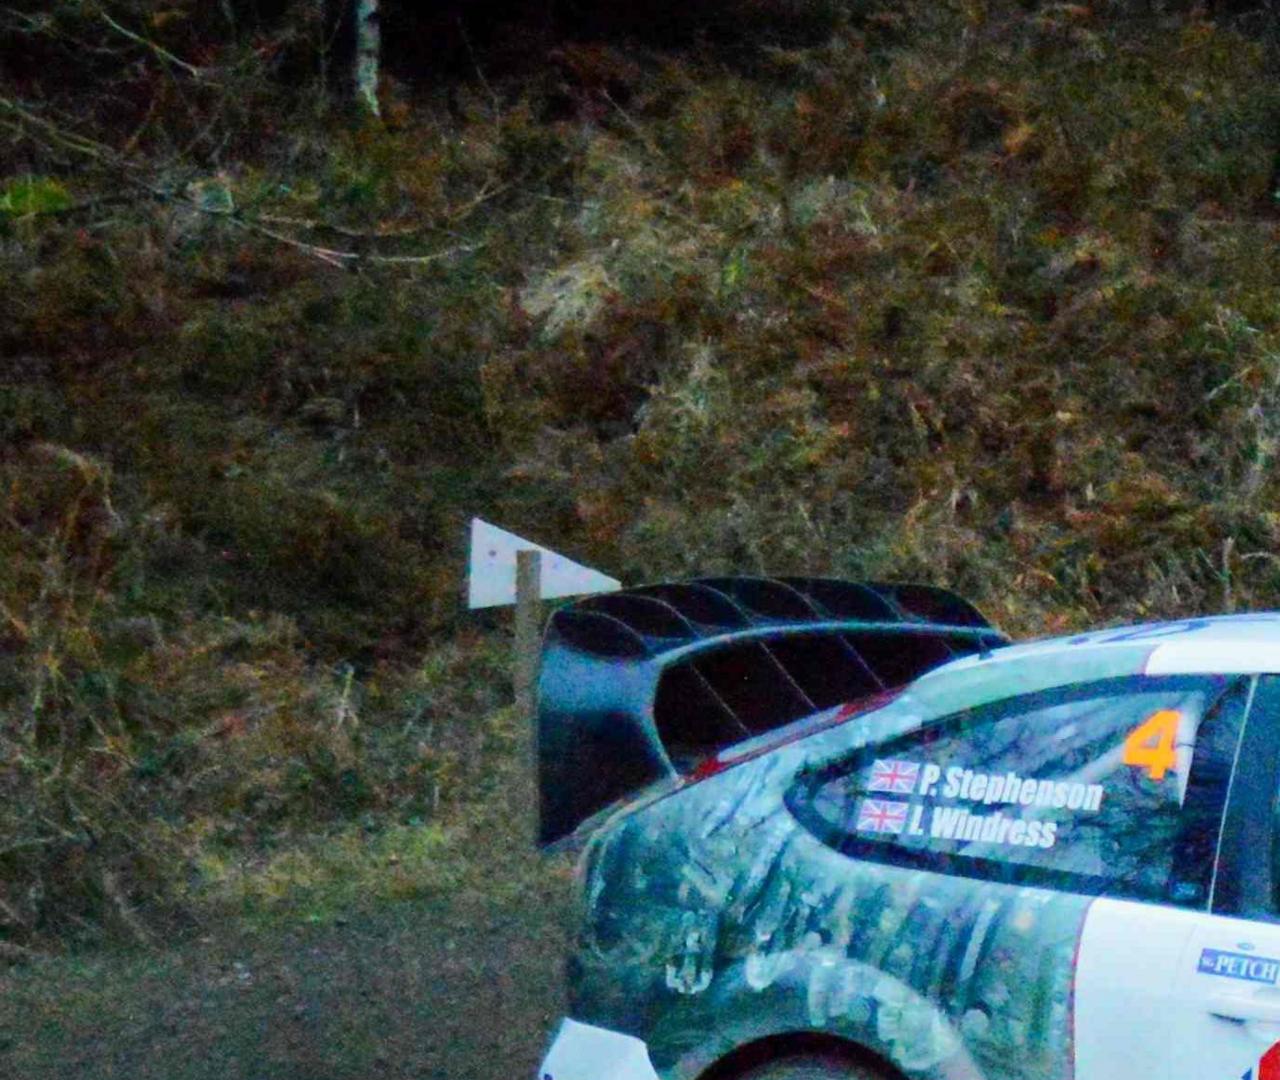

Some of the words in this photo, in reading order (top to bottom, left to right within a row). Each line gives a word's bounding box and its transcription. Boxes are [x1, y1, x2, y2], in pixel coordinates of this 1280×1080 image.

[1122, 709, 1182, 781] 4
[918, 764, 938, 797] P.
[943, 767, 1104, 812] Stephenson
[932, 806, 1057, 849] Windress
[1214, 954, 1278, 982] PETCH
